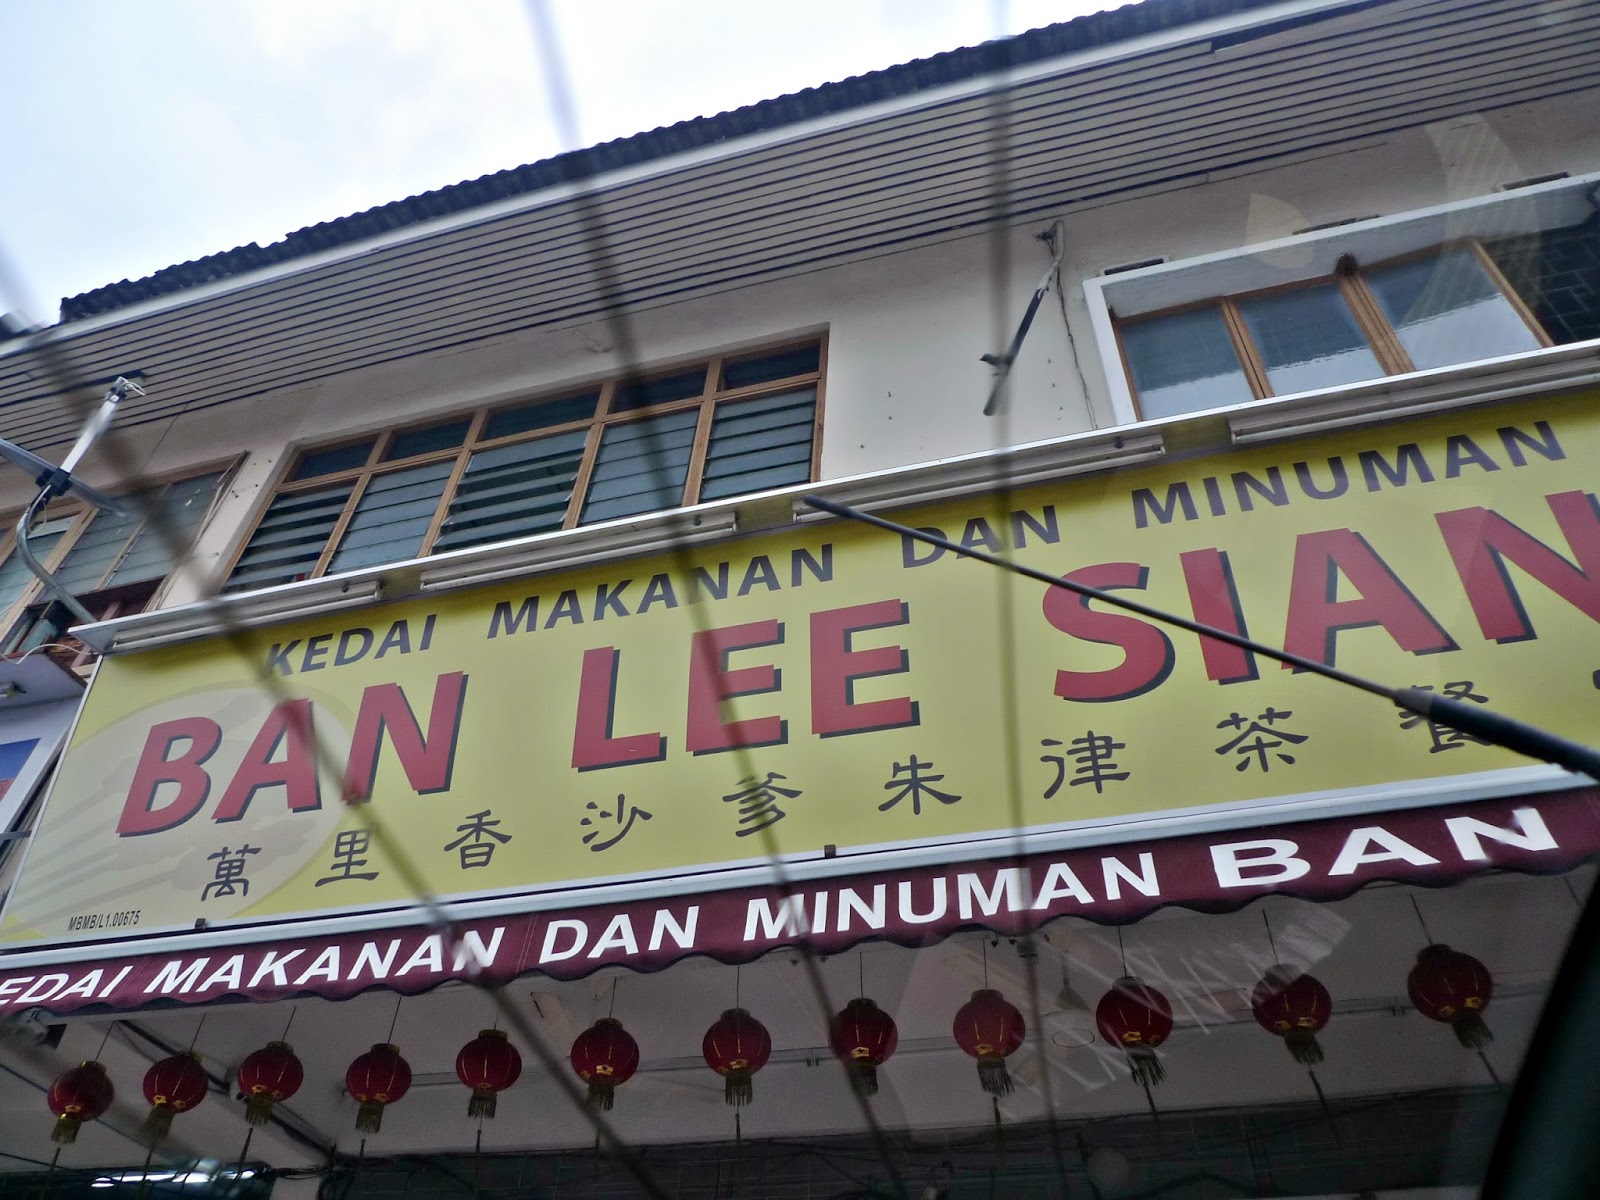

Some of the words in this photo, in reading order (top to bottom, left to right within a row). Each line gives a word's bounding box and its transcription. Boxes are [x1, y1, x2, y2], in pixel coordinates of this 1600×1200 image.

[116, 670, 469, 837] BAN
[571, 598, 920, 773] LEE
[1043, 490, 1600, 702] SIAN
[269, 614, 435, 675] KEDAI
[488, 543, 834, 638] MAKANAN
[902, 505, 1061, 569] DAN
[1132, 420, 1567, 529] MINUMAN
[143, 927, 506, 994] MAKANAN
[538, 905, 700, 965] DAN
[743, 852, 1160, 941] MINUMAN
[1210, 807, 1560, 888] BAN
